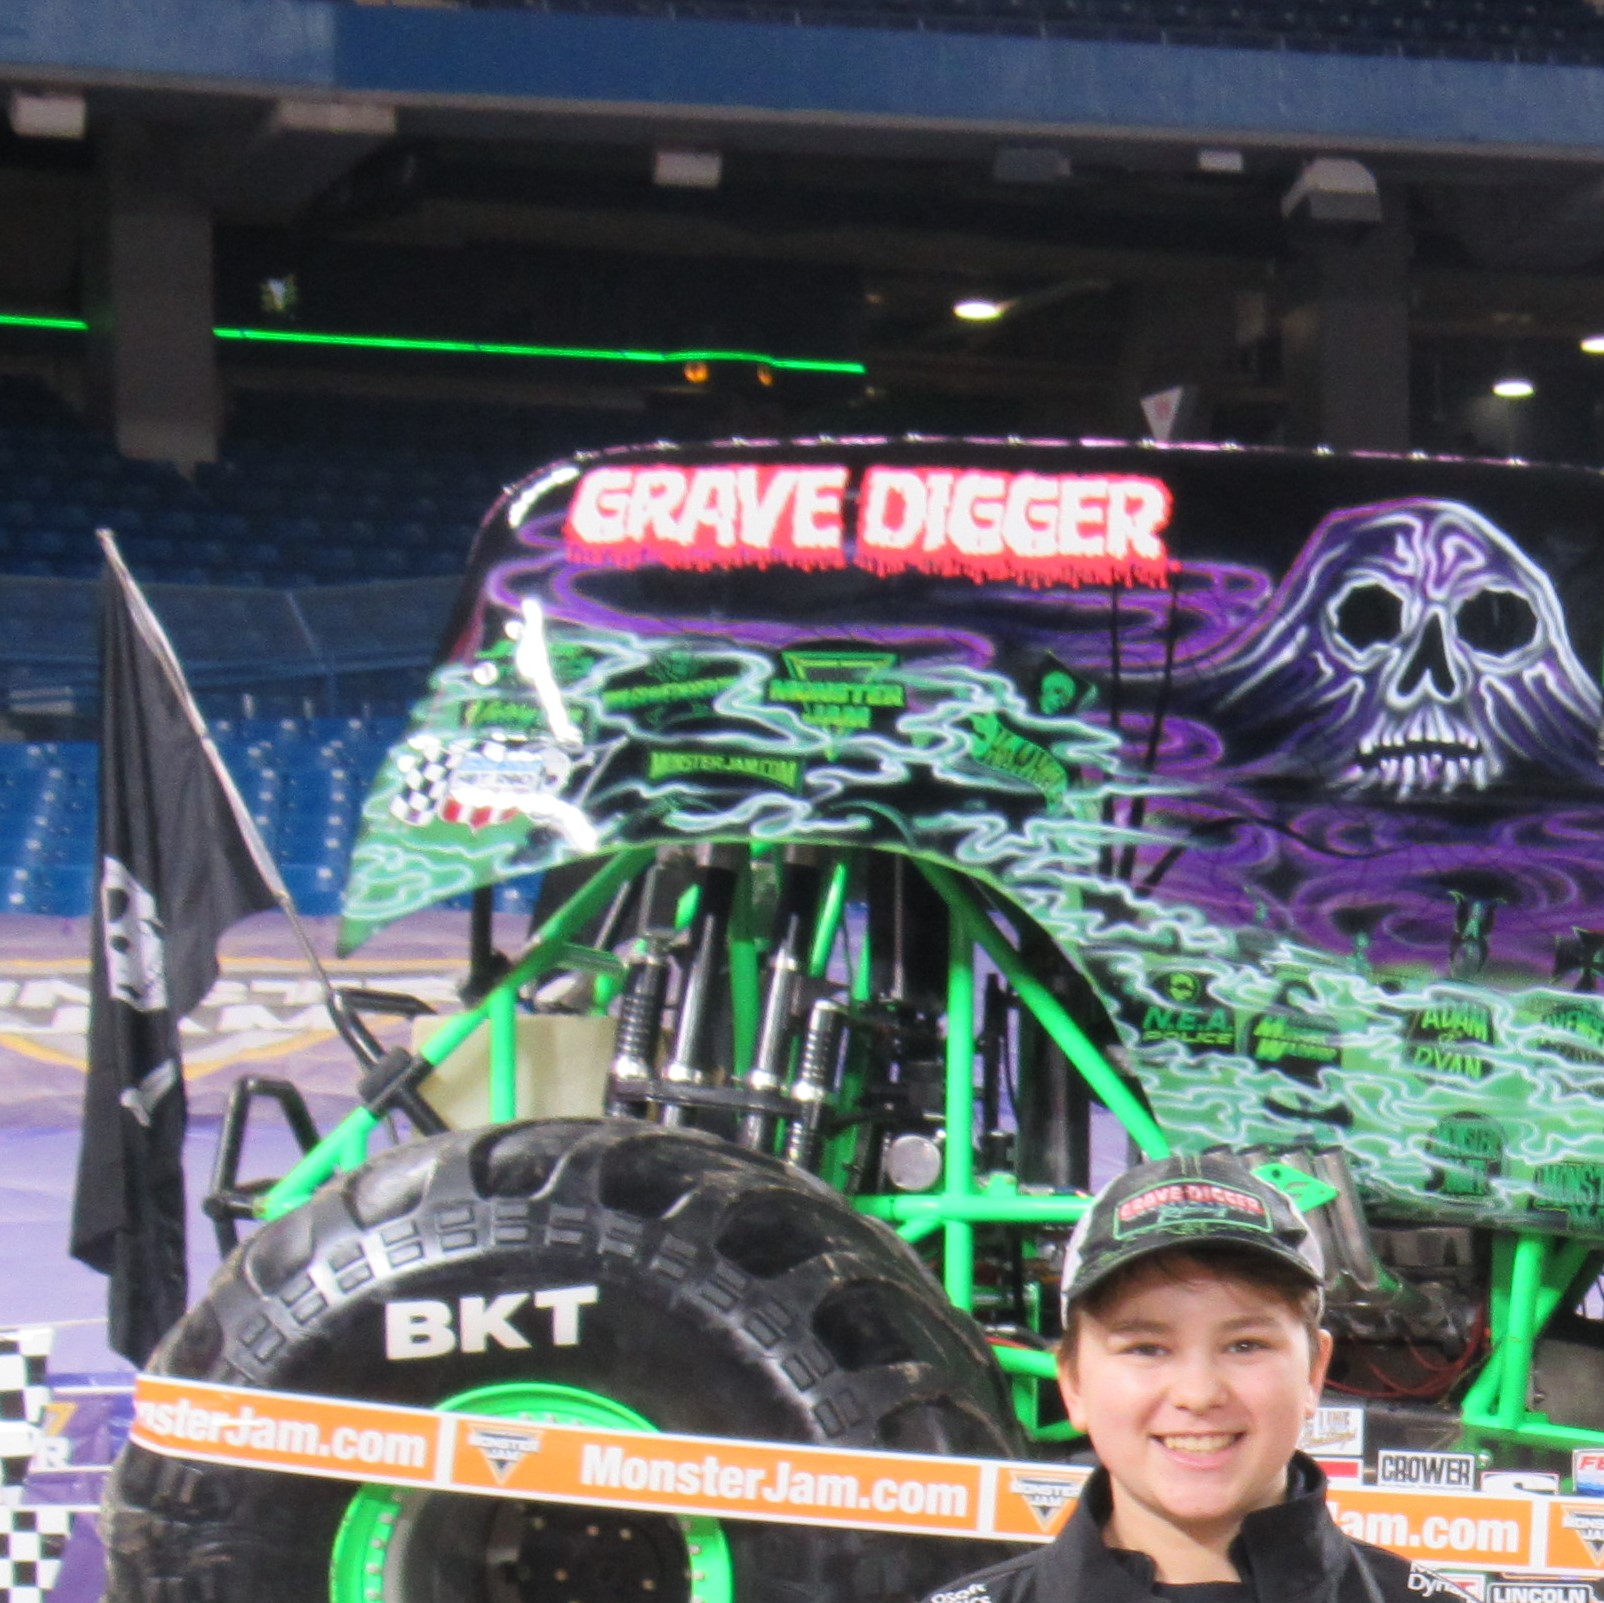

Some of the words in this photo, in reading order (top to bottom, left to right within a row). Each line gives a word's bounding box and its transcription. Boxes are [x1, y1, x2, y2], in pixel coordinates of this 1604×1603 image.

[571, 465, 847, 563] GRAVE
[857, 465, 1173, 577] DIGGER
[386, 1285, 598, 1361] BKT
[581, 1445, 968, 1517] MonsterJam.com
[1382, 1455, 1470, 1486] CROWER
